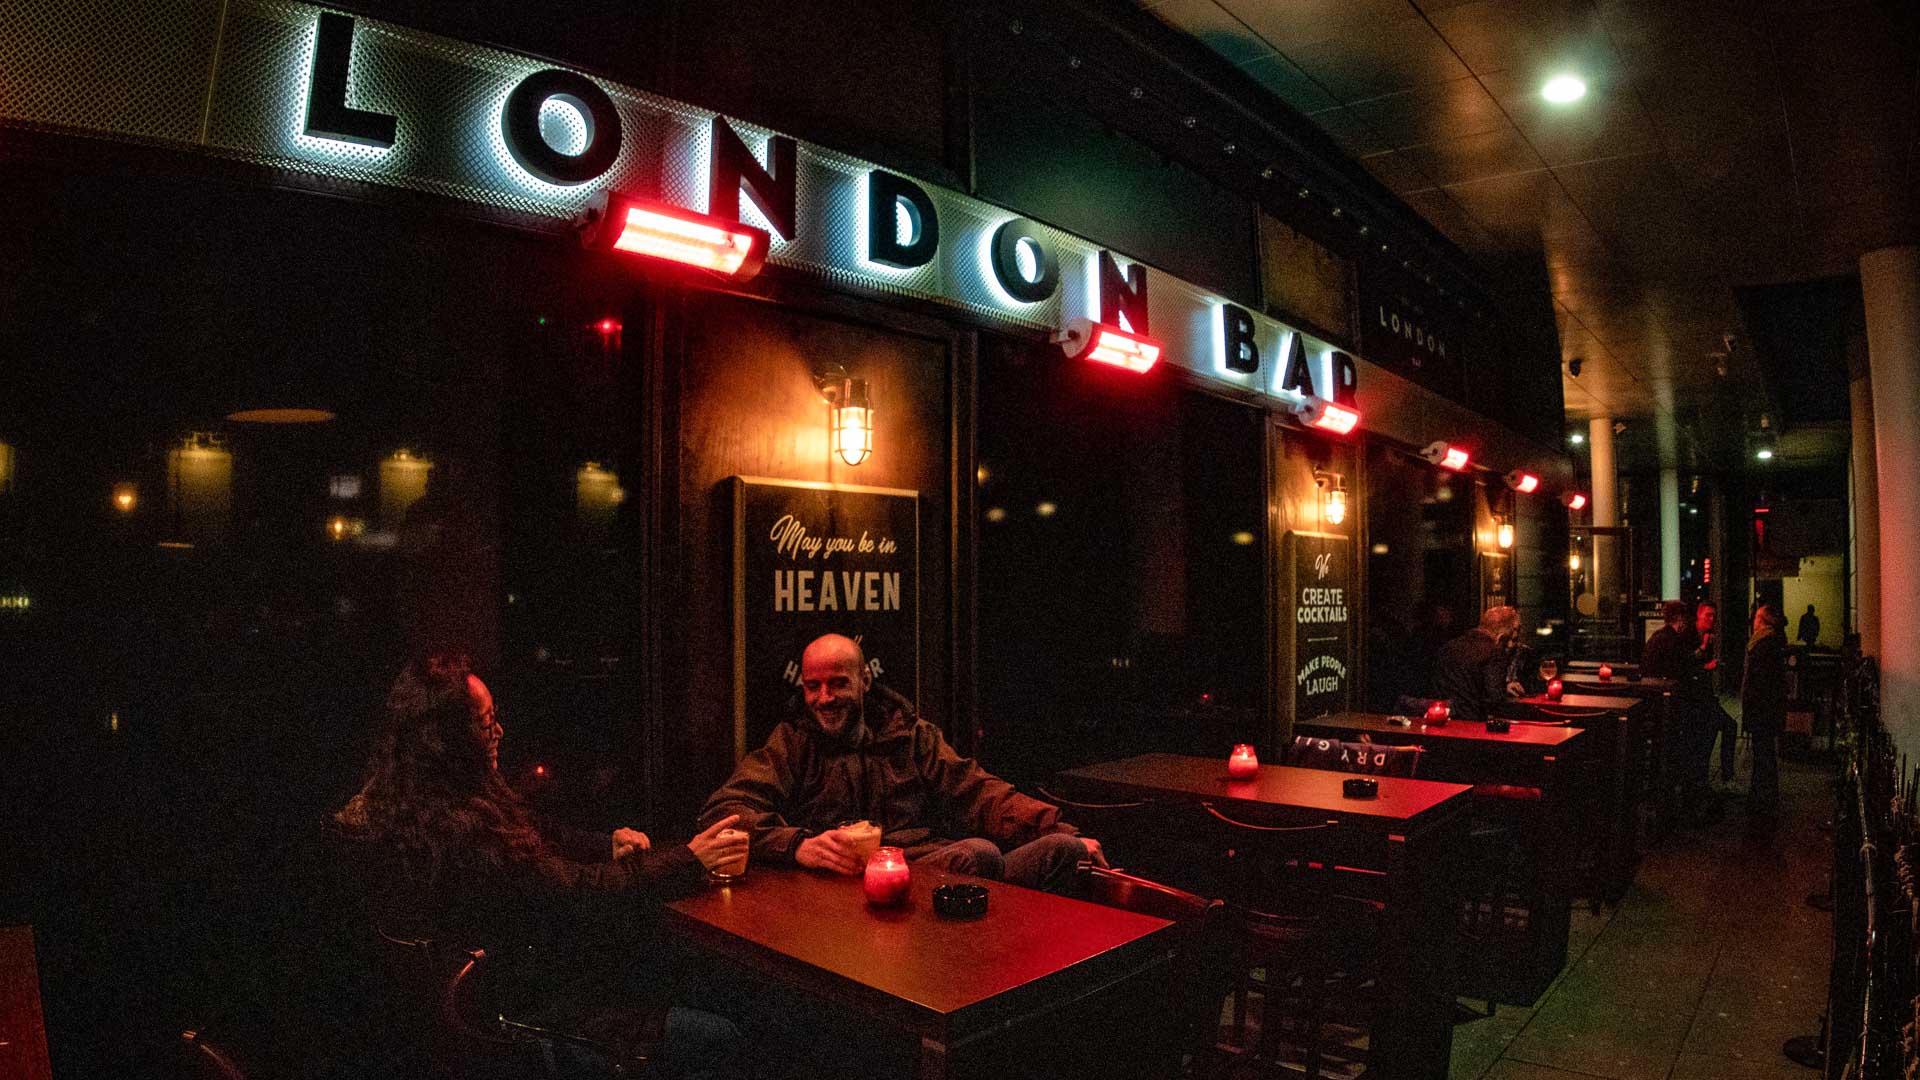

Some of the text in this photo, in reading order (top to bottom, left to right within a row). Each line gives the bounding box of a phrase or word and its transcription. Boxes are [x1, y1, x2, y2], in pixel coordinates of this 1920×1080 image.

[303, 11, 1358, 410] LONDON BAR
[1379, 305, 1446, 360] LONDON
[769, 514, 898, 560] May you be in
[774, 569, 900, 612] HEAVEN
[1302, 587, 1343, 606] CREATE
[1297, 606, 1347, 624] COCKTAILS
[1297, 655, 1346, 686] MAKE PEOPLE
[1306, 676, 1339, 695] LAUGH
[1341, 749, 1386, 766] DRY
